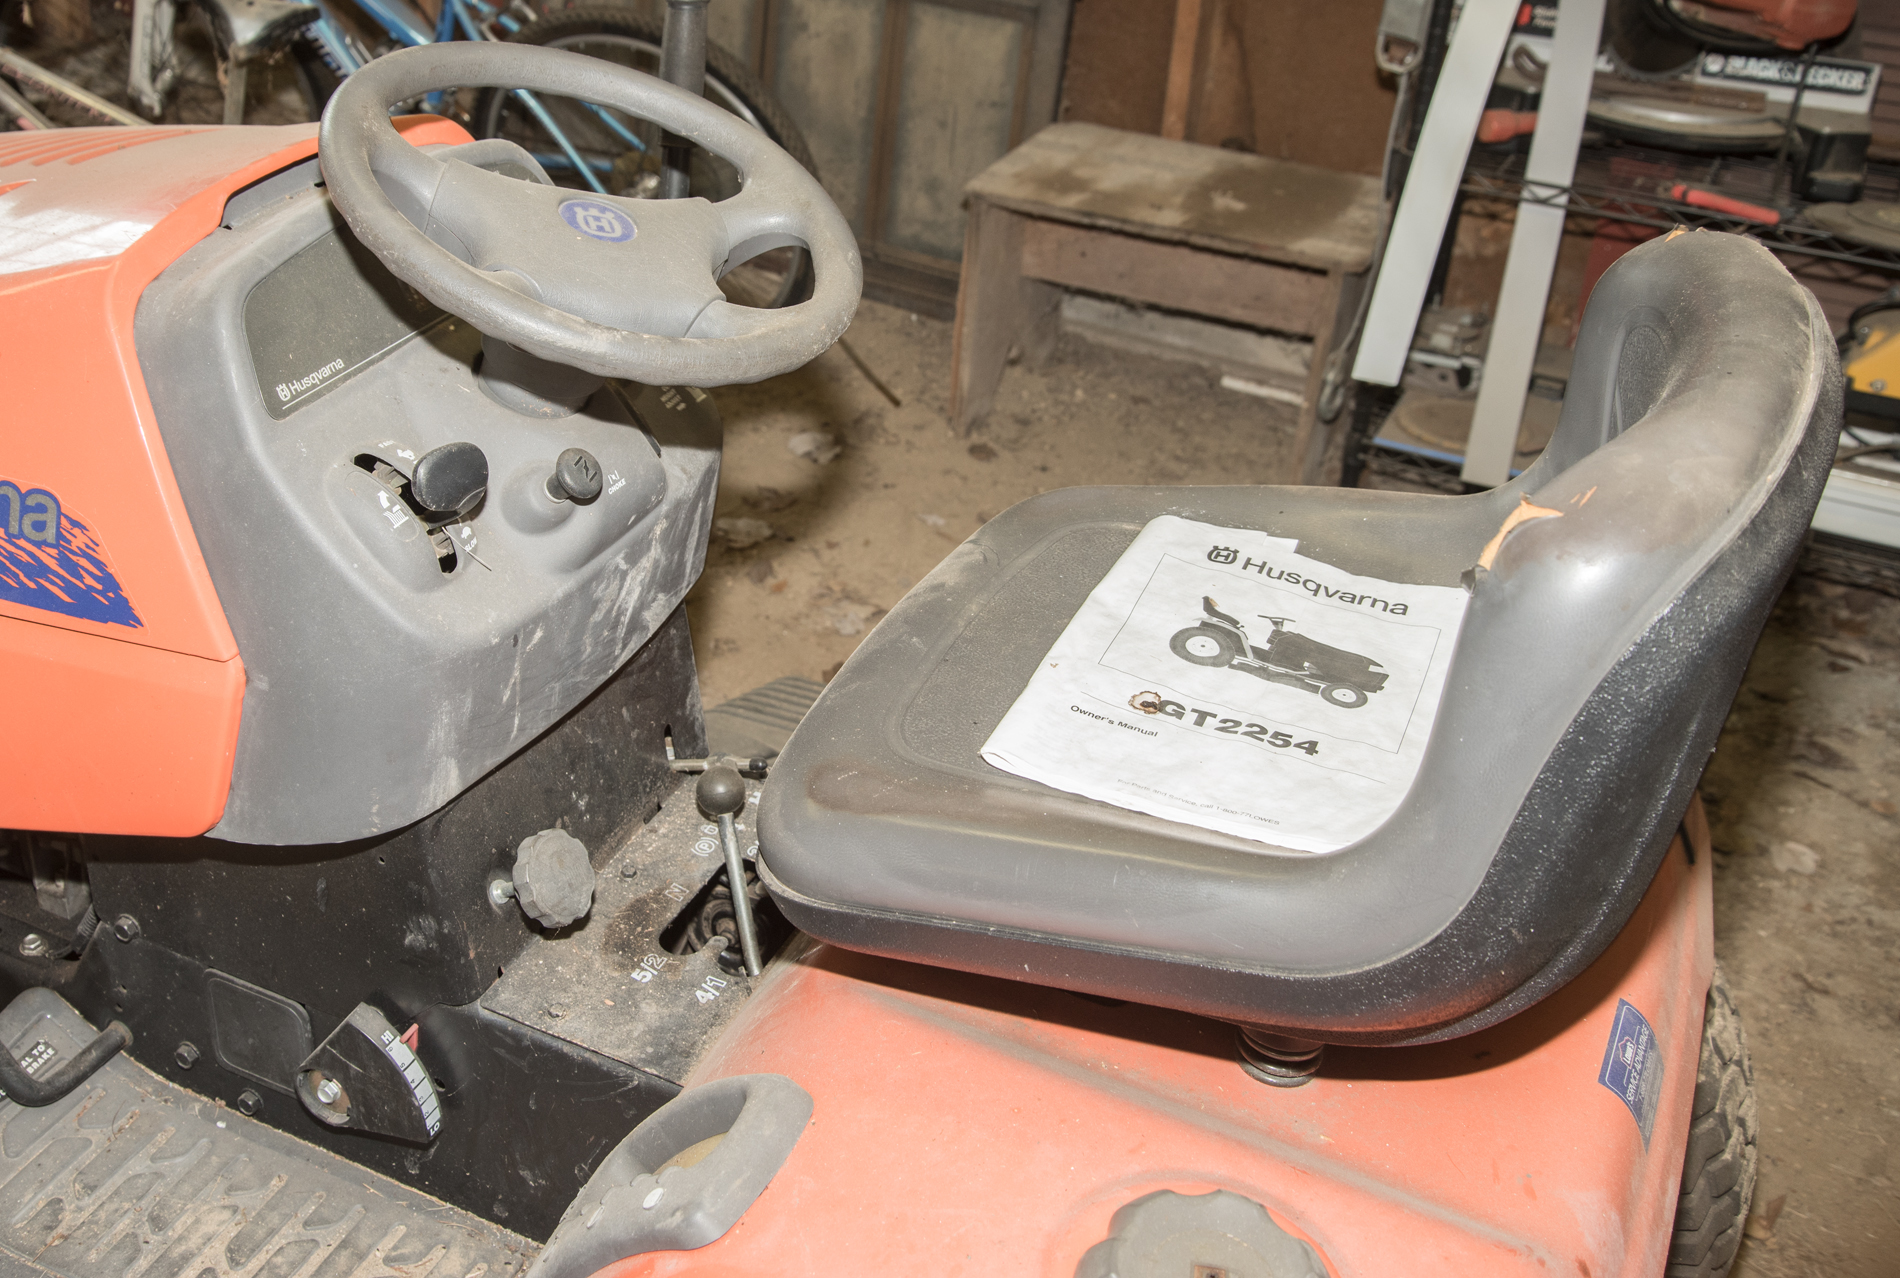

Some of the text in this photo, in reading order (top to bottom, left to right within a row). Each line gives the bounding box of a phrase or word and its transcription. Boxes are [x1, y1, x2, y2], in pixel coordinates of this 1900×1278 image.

[288, 358, 345, 395] Husqvarna
[608, 477, 627, 495] CHOKE
[1241, 556, 1409, 616] Husqvarna
[1070, 704, 1159, 738] Owner's Manual
[1131, 782, 1150, 792] Parts
[1152, 788, 1168, 798] and
[665, 882, 690, 902] N
[630, 953, 668, 983] 5/2
[695, 974, 728, 1004] 4/1
[381, 1030, 394, 1044] HI
[1627, 1069, 1640, 1104] SERVICE
[429, 1122, 440, 1137] LO
